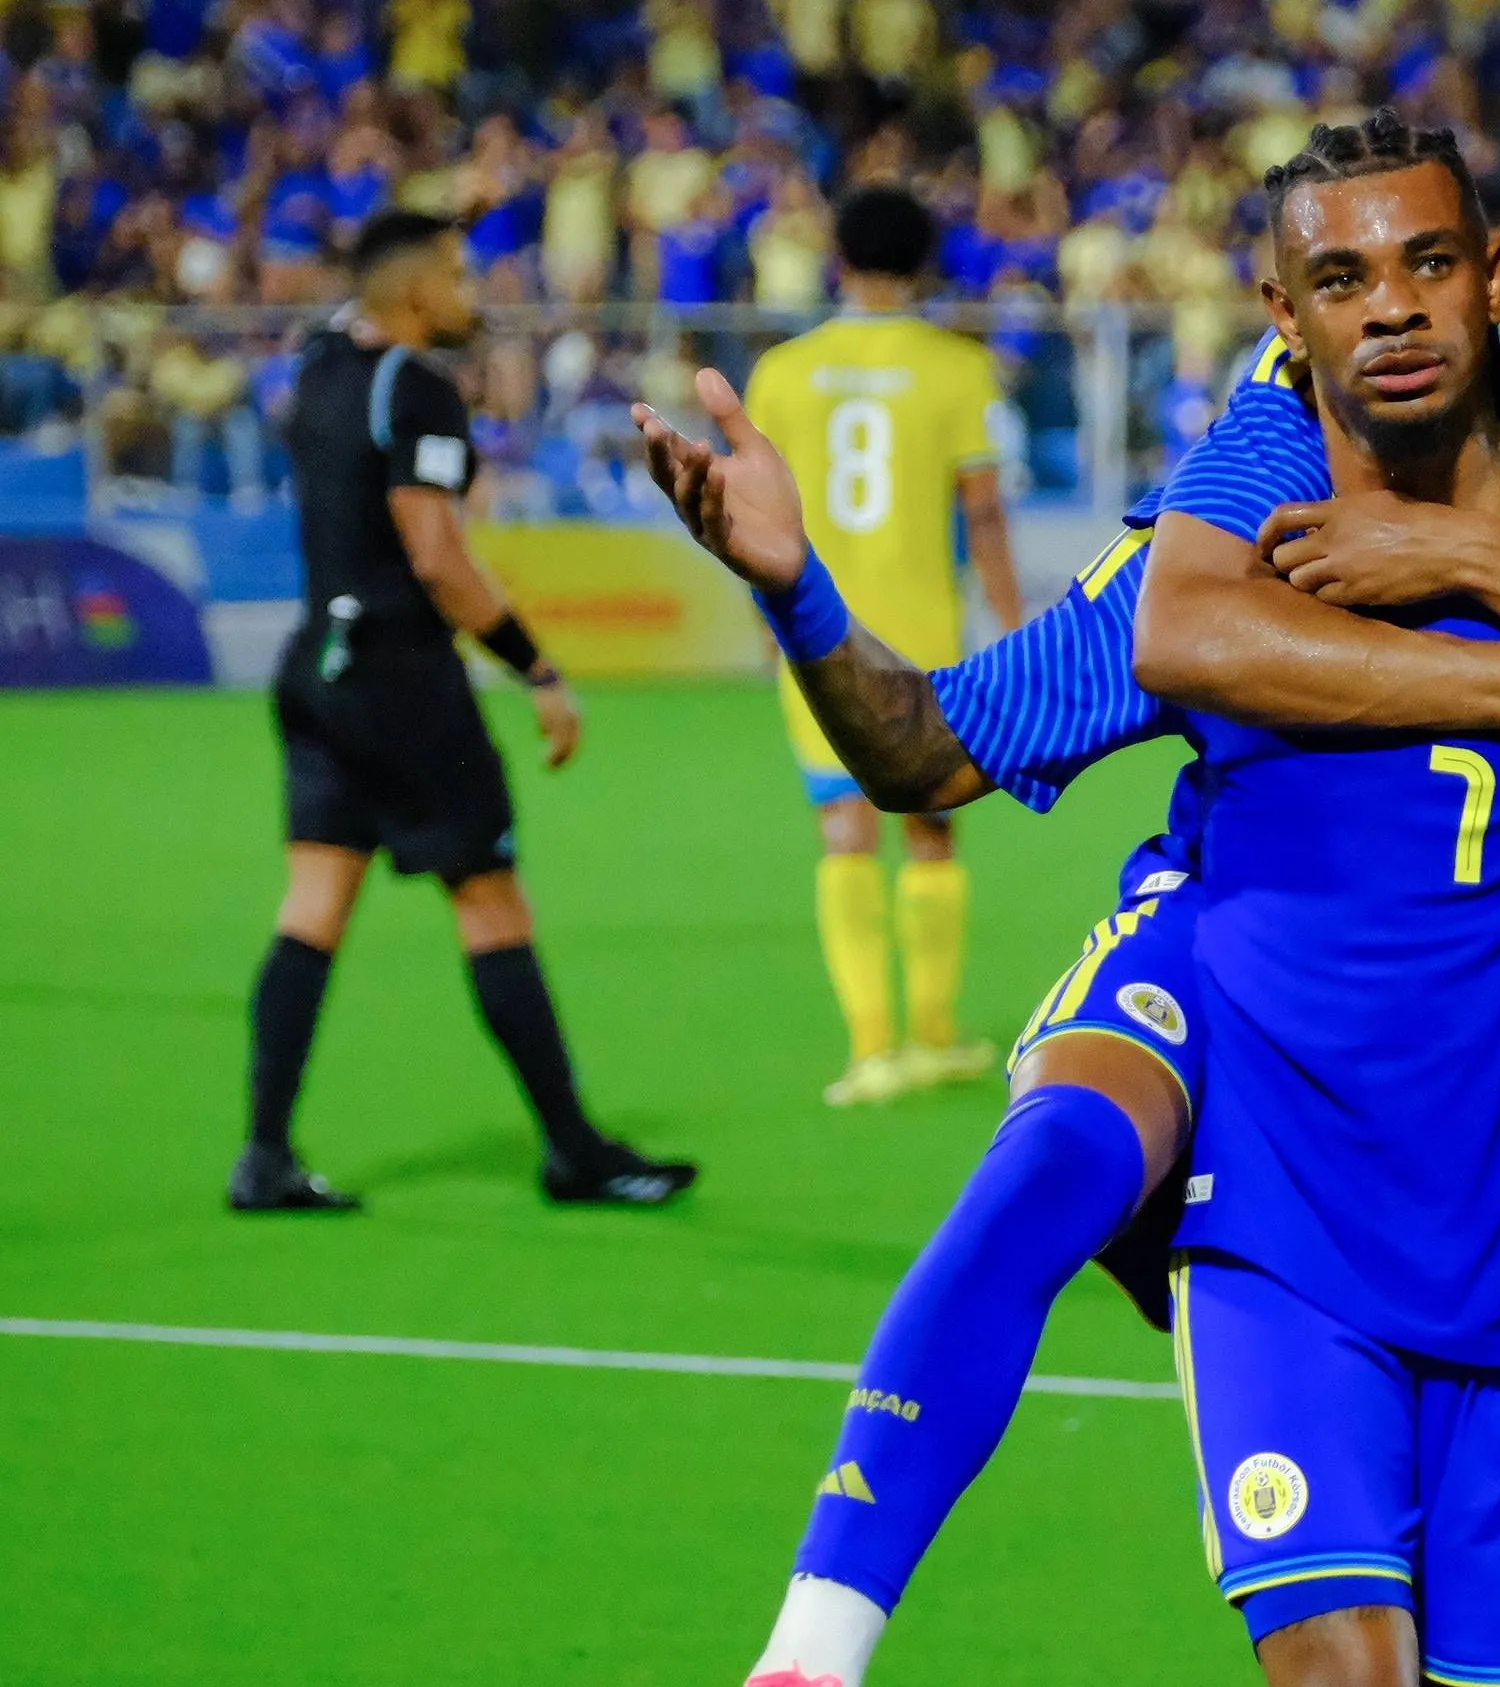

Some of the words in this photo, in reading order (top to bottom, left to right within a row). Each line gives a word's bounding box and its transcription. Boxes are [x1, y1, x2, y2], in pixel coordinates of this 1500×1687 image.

[826, 399, 893, 533] 8
[1429, 744, 1496, 884] 7
[1252, 1458, 1291, 1474] Futbol
